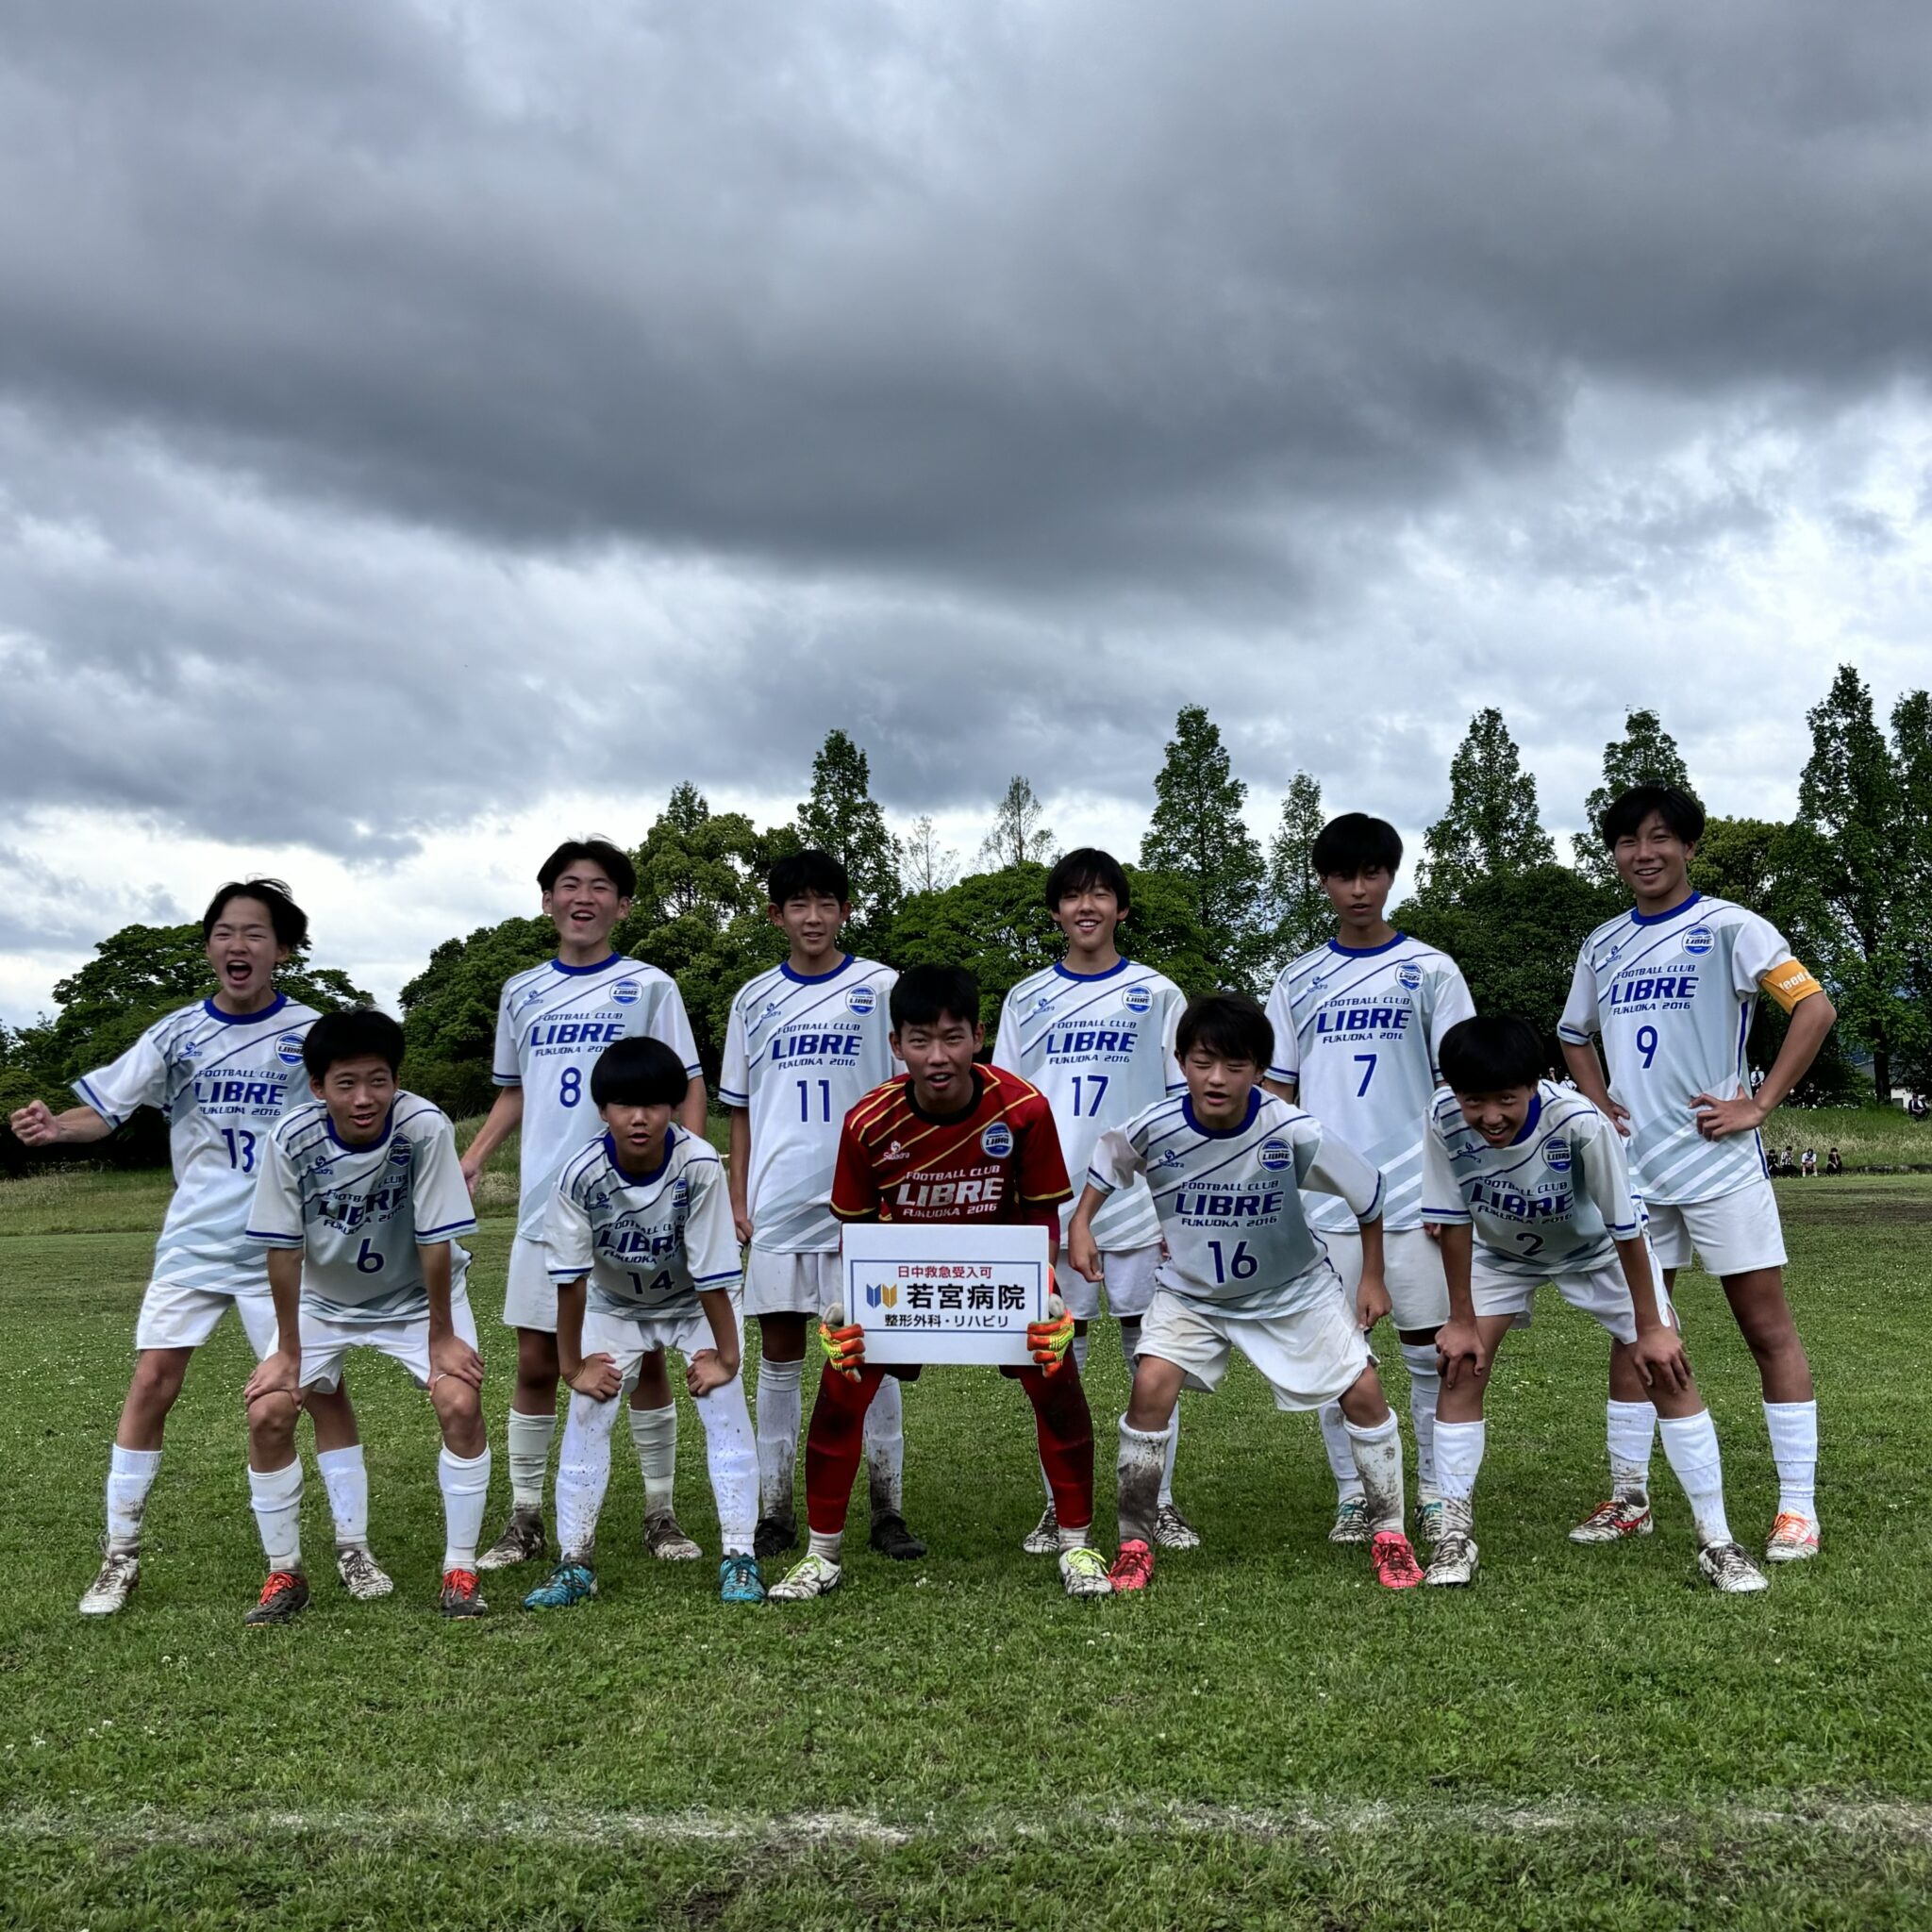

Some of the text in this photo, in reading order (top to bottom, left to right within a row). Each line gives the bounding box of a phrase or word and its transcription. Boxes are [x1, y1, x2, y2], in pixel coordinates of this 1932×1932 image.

[1616, 966, 1663, 978] FOOTBALL
[1323, 996, 1410, 1008] FOOTBALL CLUB
[1610, 977, 1699, 1005] LIBRE
[539, 1012, 591, 1022] FOOTBALL
[1317, 1008, 1412, 1034] LIBRE
[1613, 1002, 1690, 1016] FUKUOKA 2016
[530, 1023, 625, 1046] LIBRE
[776, 1023, 860, 1035] FOOTBALL CLUB
[1051, 1020, 1138, 1029] FOOTBALL CLUB
[772, 1034, 863, 1060] LIBRE
[1046, 1031, 1139, 1055] LIBRE
[1323, 1033, 1373, 1044] FUKUOKA
[1636, 1025, 1658, 1069] 9
[535, 1046, 581, 1058] FUKUOKA
[1049, 1054, 1130, 1065] FUKUOKA 2016
[197, 1069, 288, 1081] FOOTBALL CLUB
[778, 1058, 856, 1071] FUKUOKA 2016
[1354, 1054, 1377, 1097] 7
[194, 1081, 289, 1106] LIBRE
[559, 1067, 582, 1108] 8
[1072, 1074, 1108, 1117] 17
[251, 1108, 281, 1116] 2016
[797, 1079, 830, 1123] 11
[221, 1128, 256, 1173] 13
[906, 1165, 1001, 1182] FOOTBALL CLUB
[1181, 1180, 1279, 1191] FOOTBALL CLUB
[897, 1177, 1005, 1207] LIBRE
[1538, 1181, 1568, 1193] CLUB
[318, 1188, 408, 1226] LIBRE
[903, 1204, 998, 1218] FUKUOKA 2016
[1174, 1191, 1284, 1217] LIBRE
[1470, 1183, 1574, 1218] LIBRE
[1181, 1216, 1277, 1227] FUKUOKA 2016
[597, 1224, 685, 1257] LIBRE
[1516, 1232, 1547, 1257] 2
[357, 1238, 385, 1274] 6
[1208, 1241, 1257, 1284] 16
[626, 1270, 675, 1295] 14
[898, 1266, 992, 1279] 日中救急受入可
[907, 1283, 1025, 1310] 若宮病院
[884, 1314, 1008, 1328] 整形外科・リハビリ
